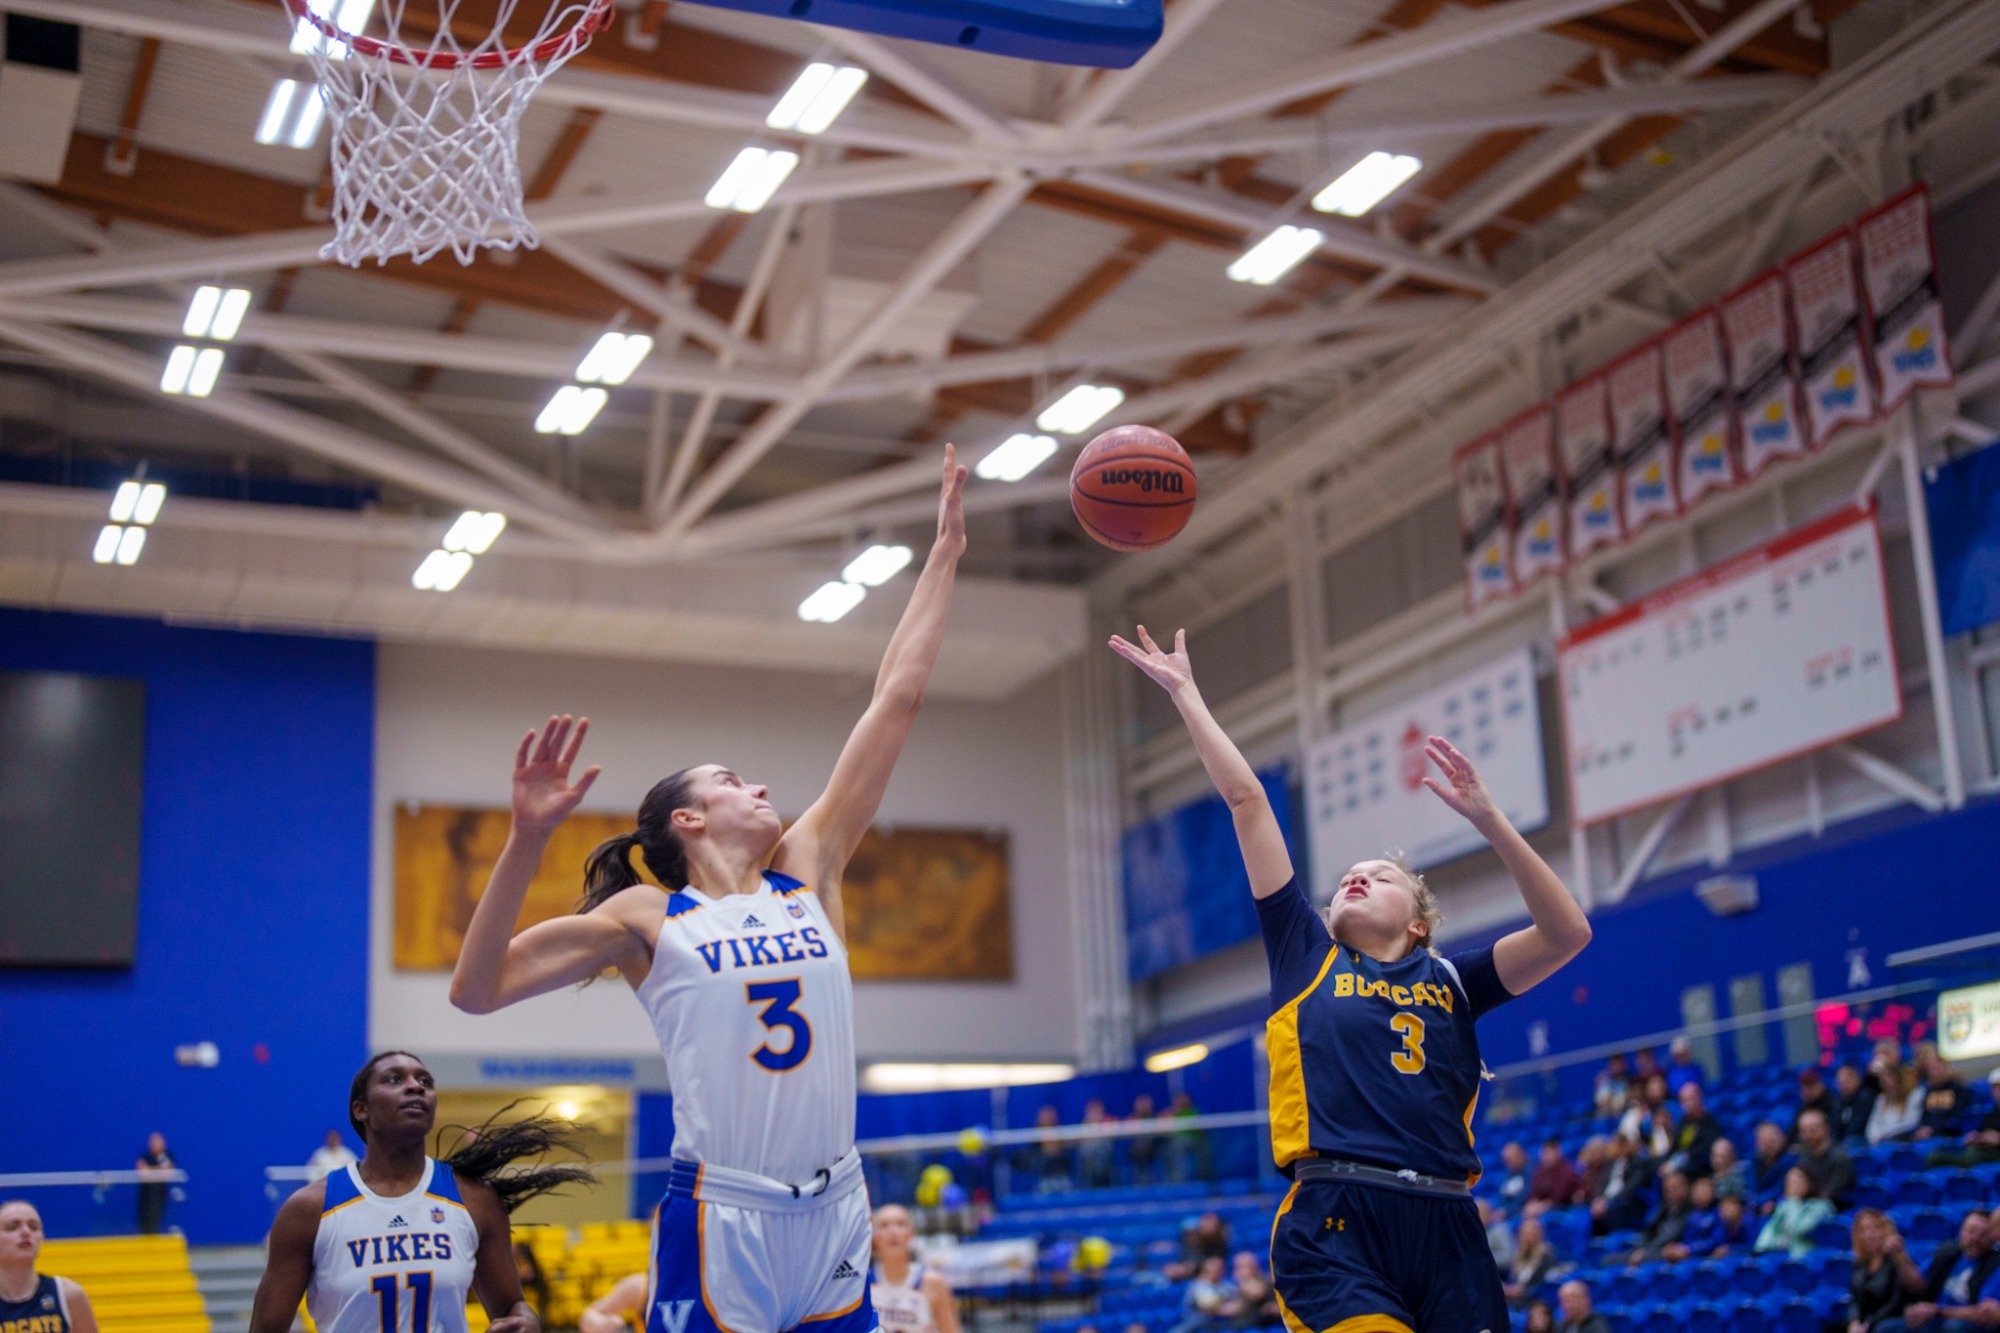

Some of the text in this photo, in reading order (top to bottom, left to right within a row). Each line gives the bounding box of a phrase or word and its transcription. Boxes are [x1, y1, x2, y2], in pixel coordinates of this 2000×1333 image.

[1101, 469, 1184, 494] Wilson
[695, 927, 828, 974] VIKES
[745, 977, 814, 1075] 3
[1390, 1011, 1426, 1075] 3
[347, 1233, 452, 1268] VIKES
[370, 1271, 434, 1333] 11
[656, 1299, 696, 1333] V
